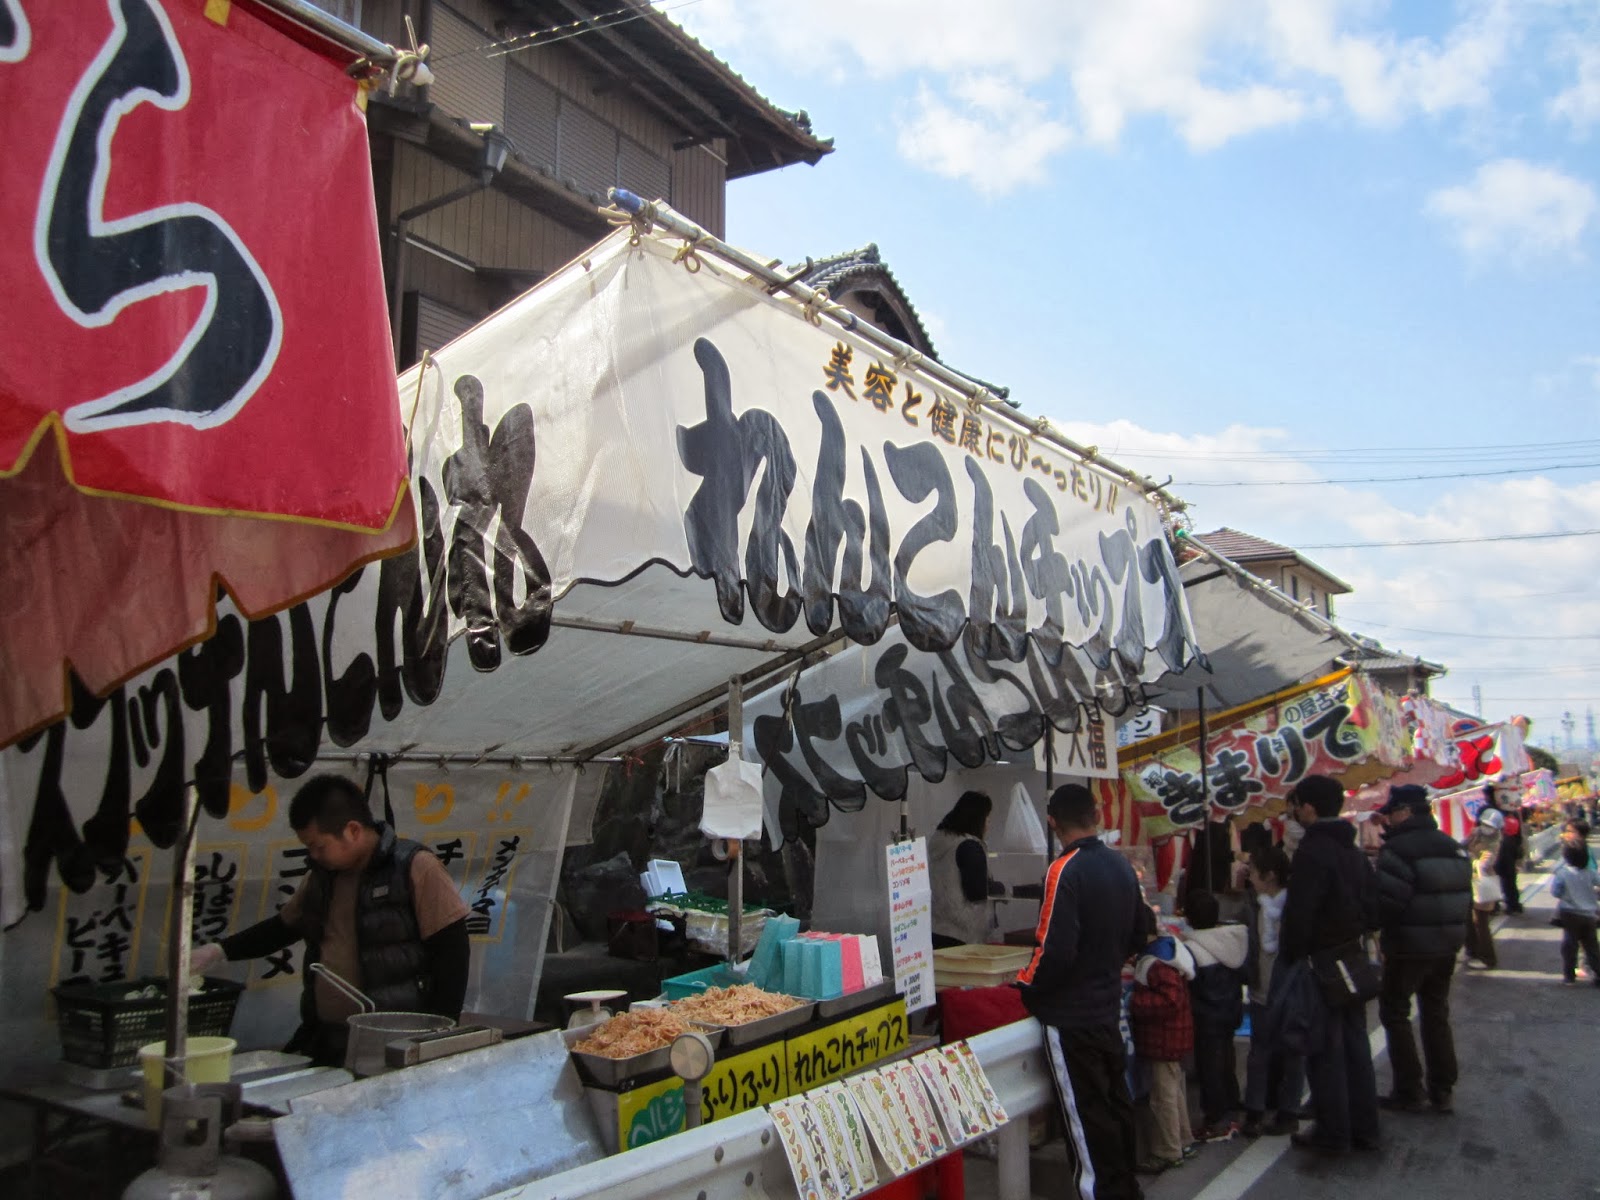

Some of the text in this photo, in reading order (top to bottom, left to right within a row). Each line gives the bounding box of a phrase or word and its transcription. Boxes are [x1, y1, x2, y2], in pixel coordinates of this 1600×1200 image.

[676, 336, 1200, 674] れんこんチップス
[795, 1013, 905, 1086] れんこんチップス
